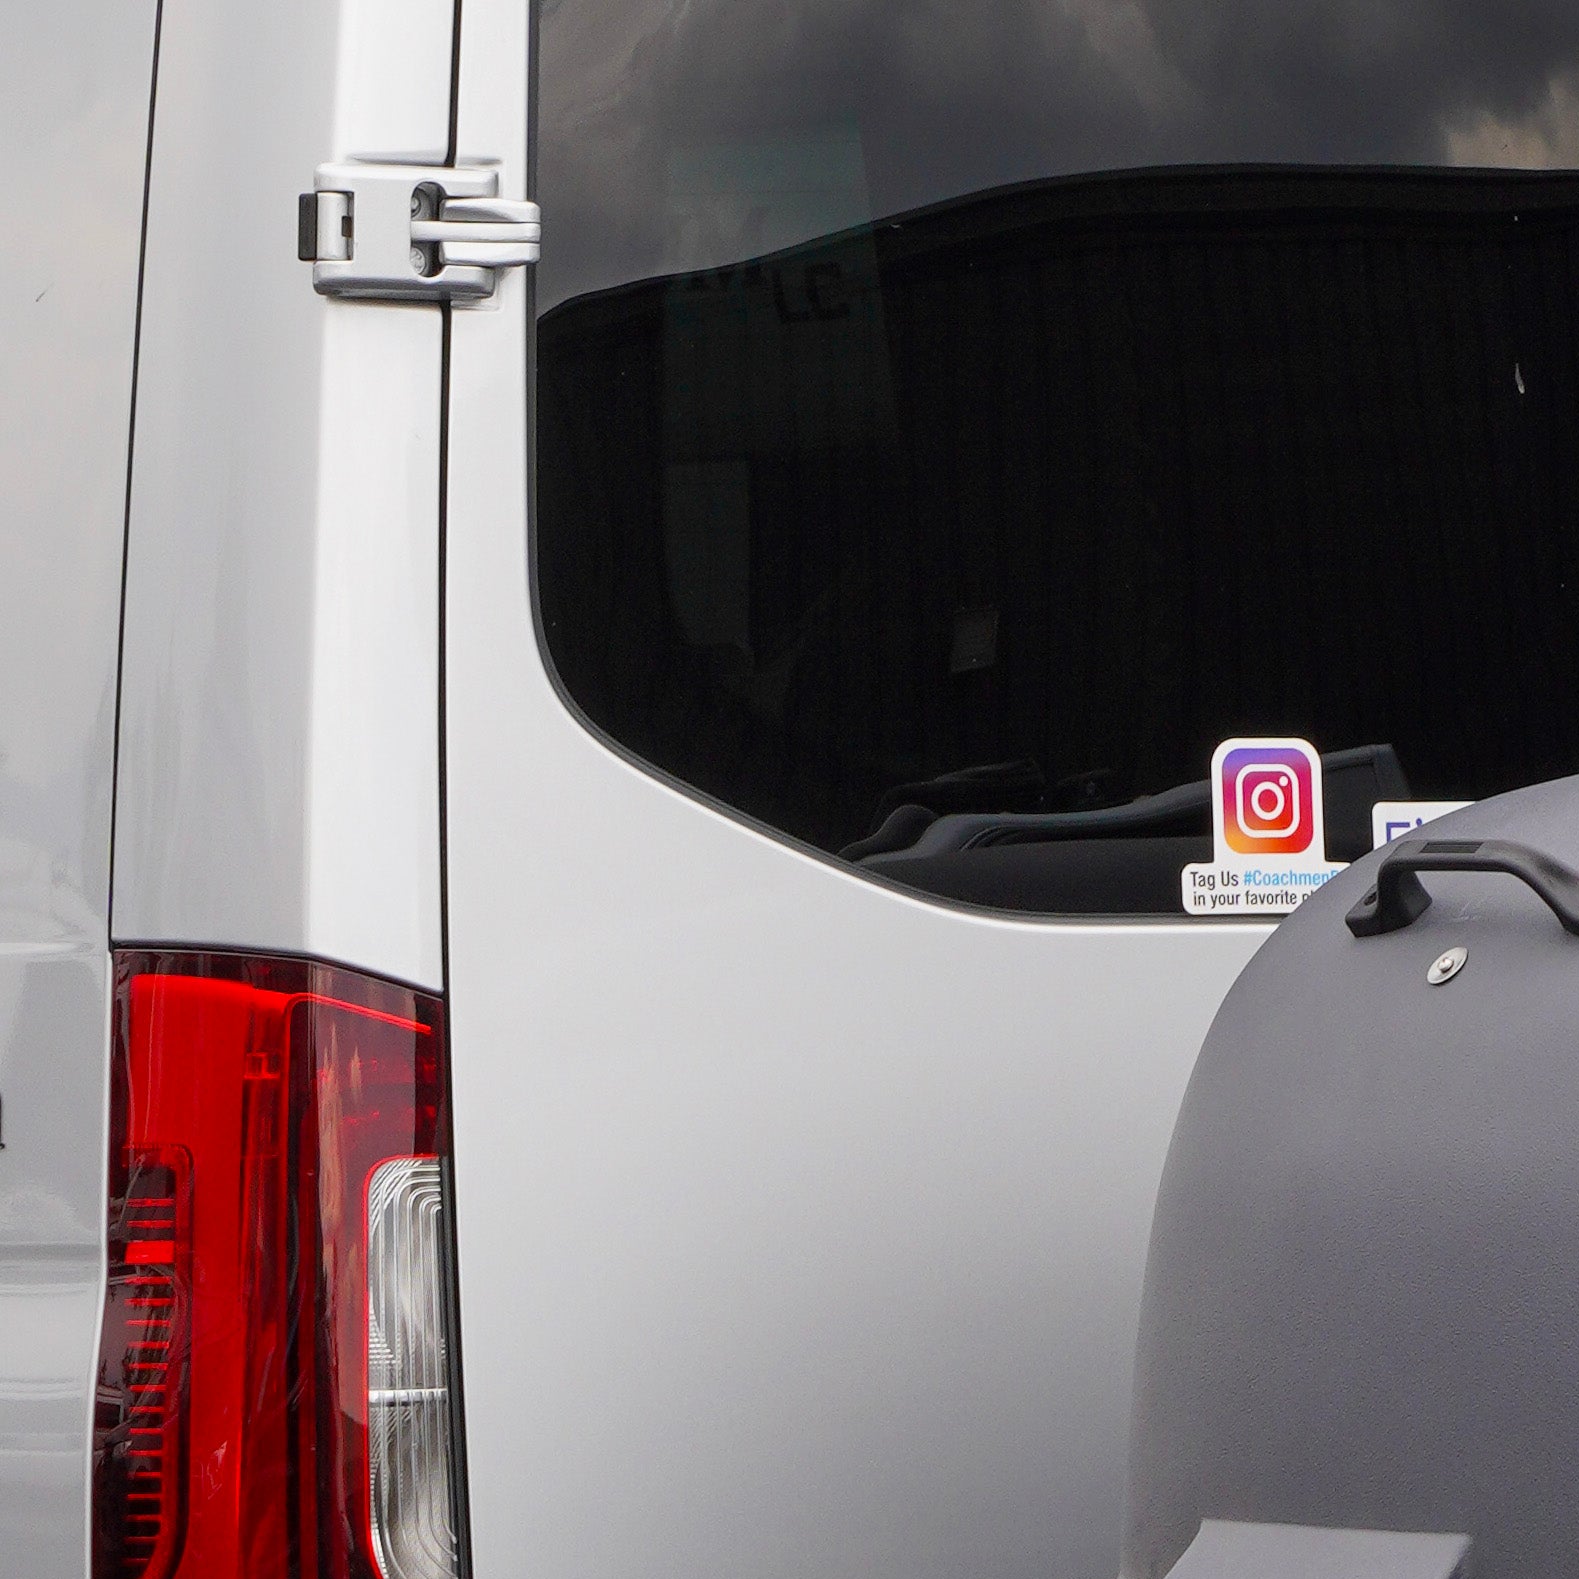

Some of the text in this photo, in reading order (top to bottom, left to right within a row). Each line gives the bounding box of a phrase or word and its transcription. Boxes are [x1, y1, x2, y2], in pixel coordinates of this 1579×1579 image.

[1190, 871, 1216, 890] Tag
[1220, 871, 1239, 886] Us
[1193, 891, 1205, 906] in
[1210, 893, 1241, 909] your
[1245, 890, 1297, 905] favorite
